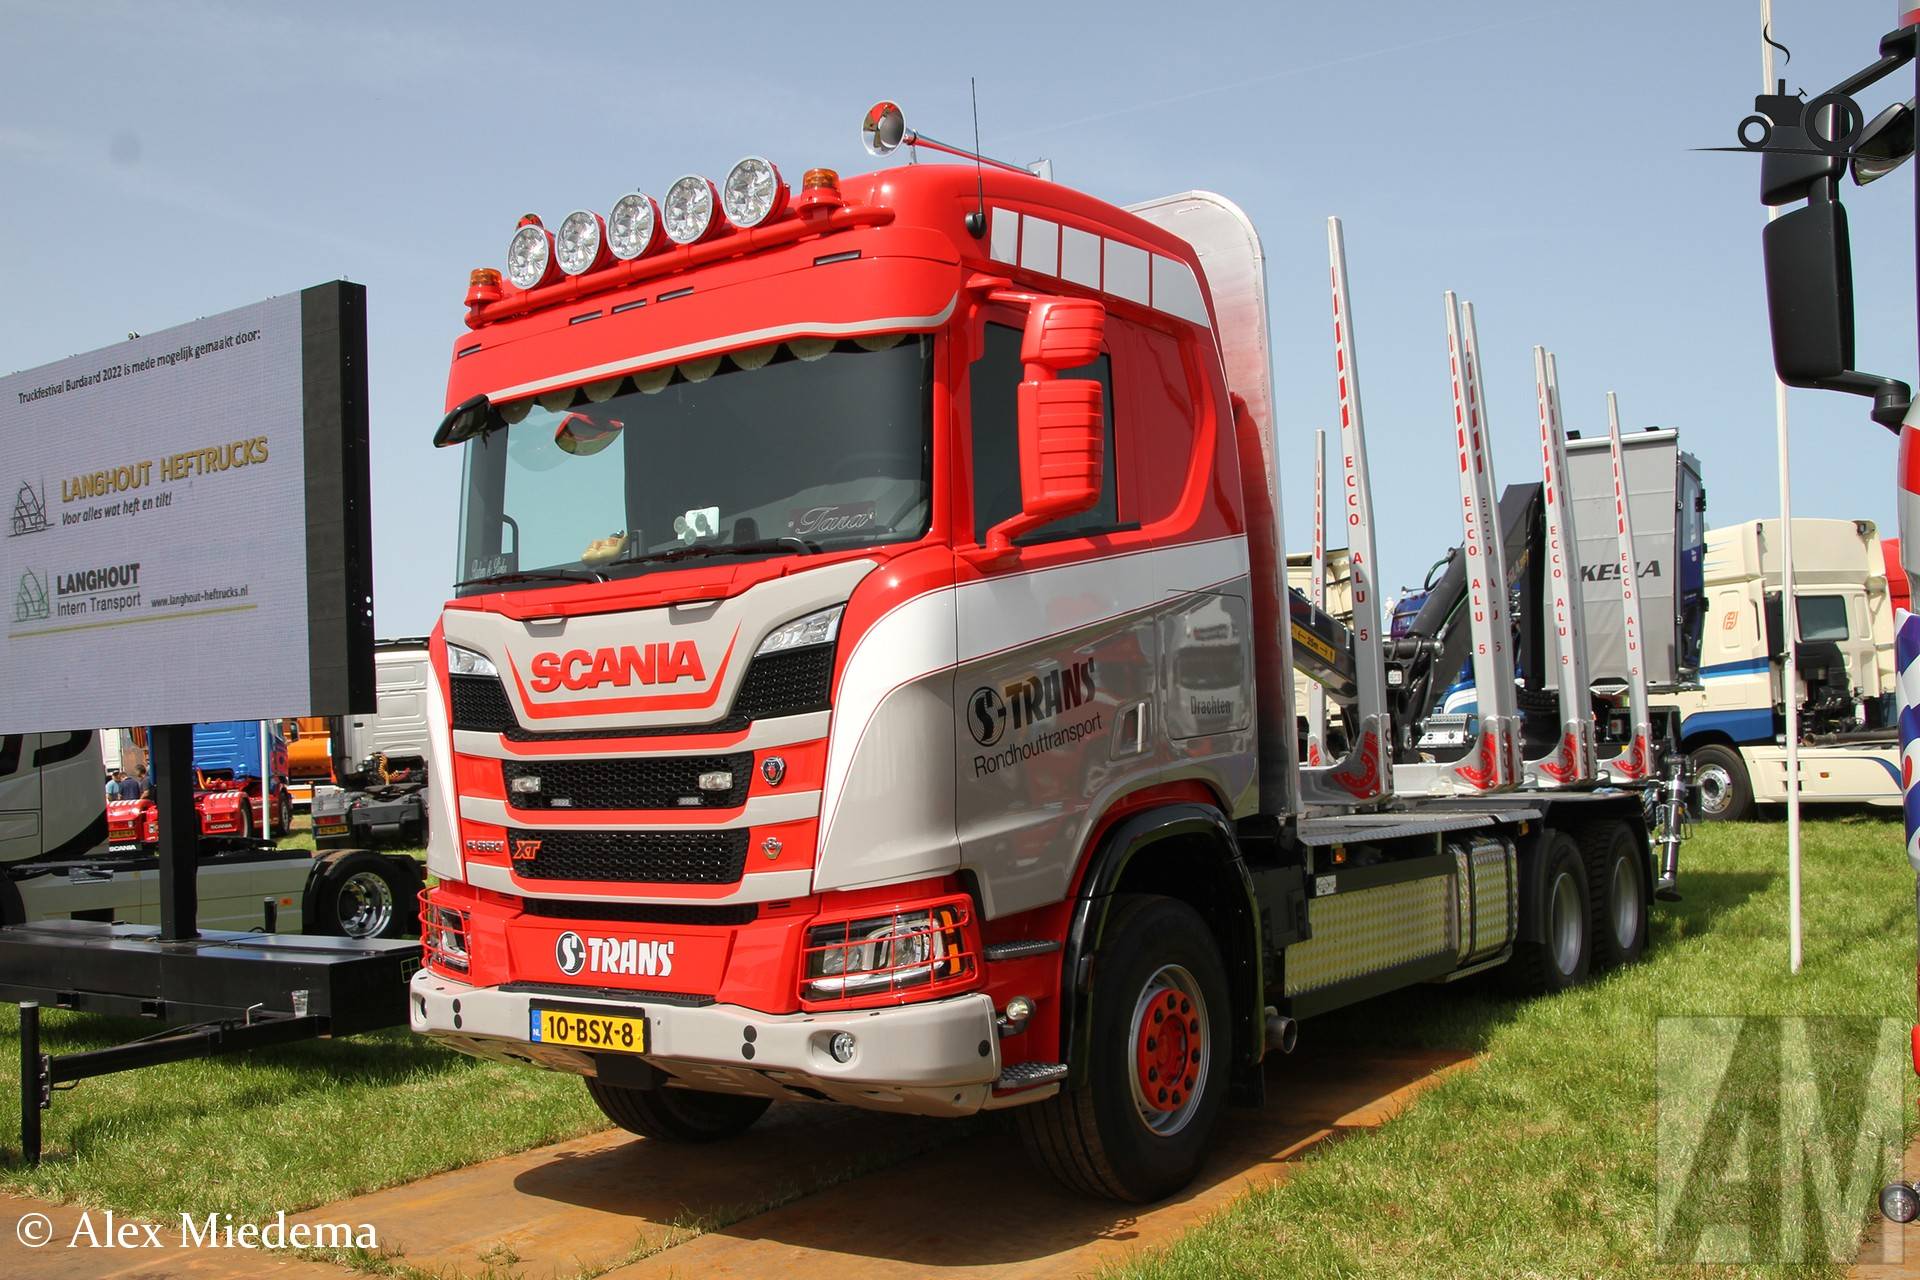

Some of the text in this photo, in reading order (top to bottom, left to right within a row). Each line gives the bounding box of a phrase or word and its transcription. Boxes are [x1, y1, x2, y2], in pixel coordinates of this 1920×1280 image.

[18, 329, 261, 404] Truckfestival Burdaard 2022 is mede mogelijk gemaakt door:
[61, 435, 269, 503] LANGHOUT HEFTRUCKS
[62, 511, 82, 526] Voor
[83, 506, 103, 521] alles
[104, 500, 121, 516] wat
[122, 496, 140, 516] heft
[142, 499, 153, 511] en
[1345, 455, 1369, 642] ECCO ALU 5
[57, 562, 141, 596] LANGHOUT
[1464, 496, 1487, 655] ECCO ALU 5
[57, 592, 141, 617] Intern Transport
[151, 584, 249, 608] www.langhout-heftrucks.nl
[1550, 525, 1569, 665] ECCO ALU 5
[1621, 552, 1639, 676] ECCO ALU 5
[530, 640, 706, 692] SCANIA
[1190, 695, 1232, 716] Drachten
[974, 711, 1103, 778] Rondhouttransport
[108, 844, 137, 852] SCANIA
[513, 840, 542, 859] XT
[532, 1028, 542, 1037] NL
[548, 1015, 634, 1048] 10-BSX-8
